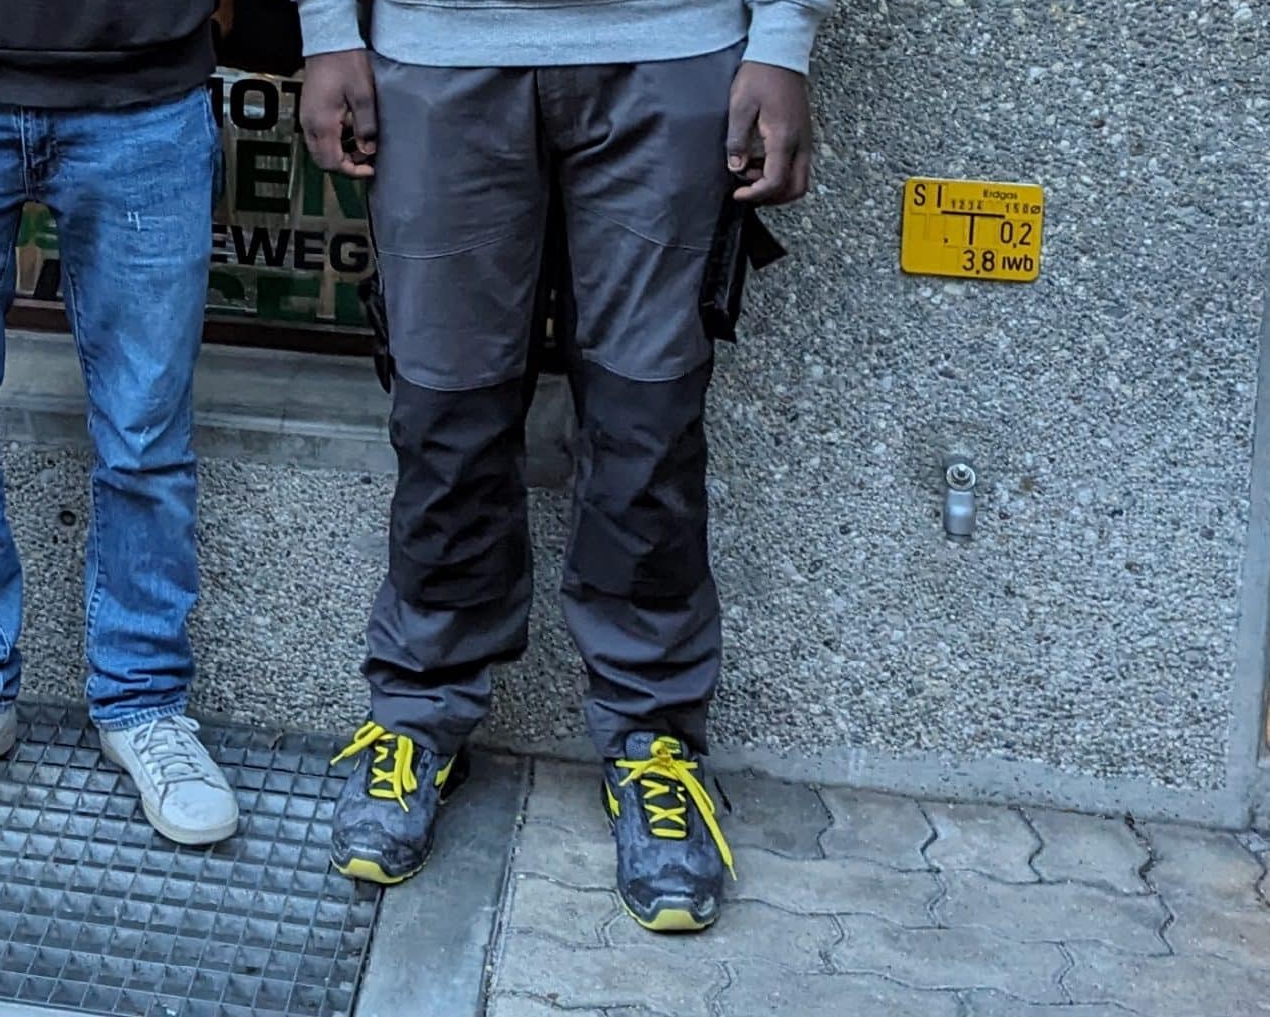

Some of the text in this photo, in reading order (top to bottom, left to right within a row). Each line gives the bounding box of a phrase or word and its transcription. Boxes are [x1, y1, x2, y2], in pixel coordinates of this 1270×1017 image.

[982, 189, 1018, 201] Erdgas
[1000, 221, 1033, 248] 0,2
[962, 250, 995, 275] 3,8
